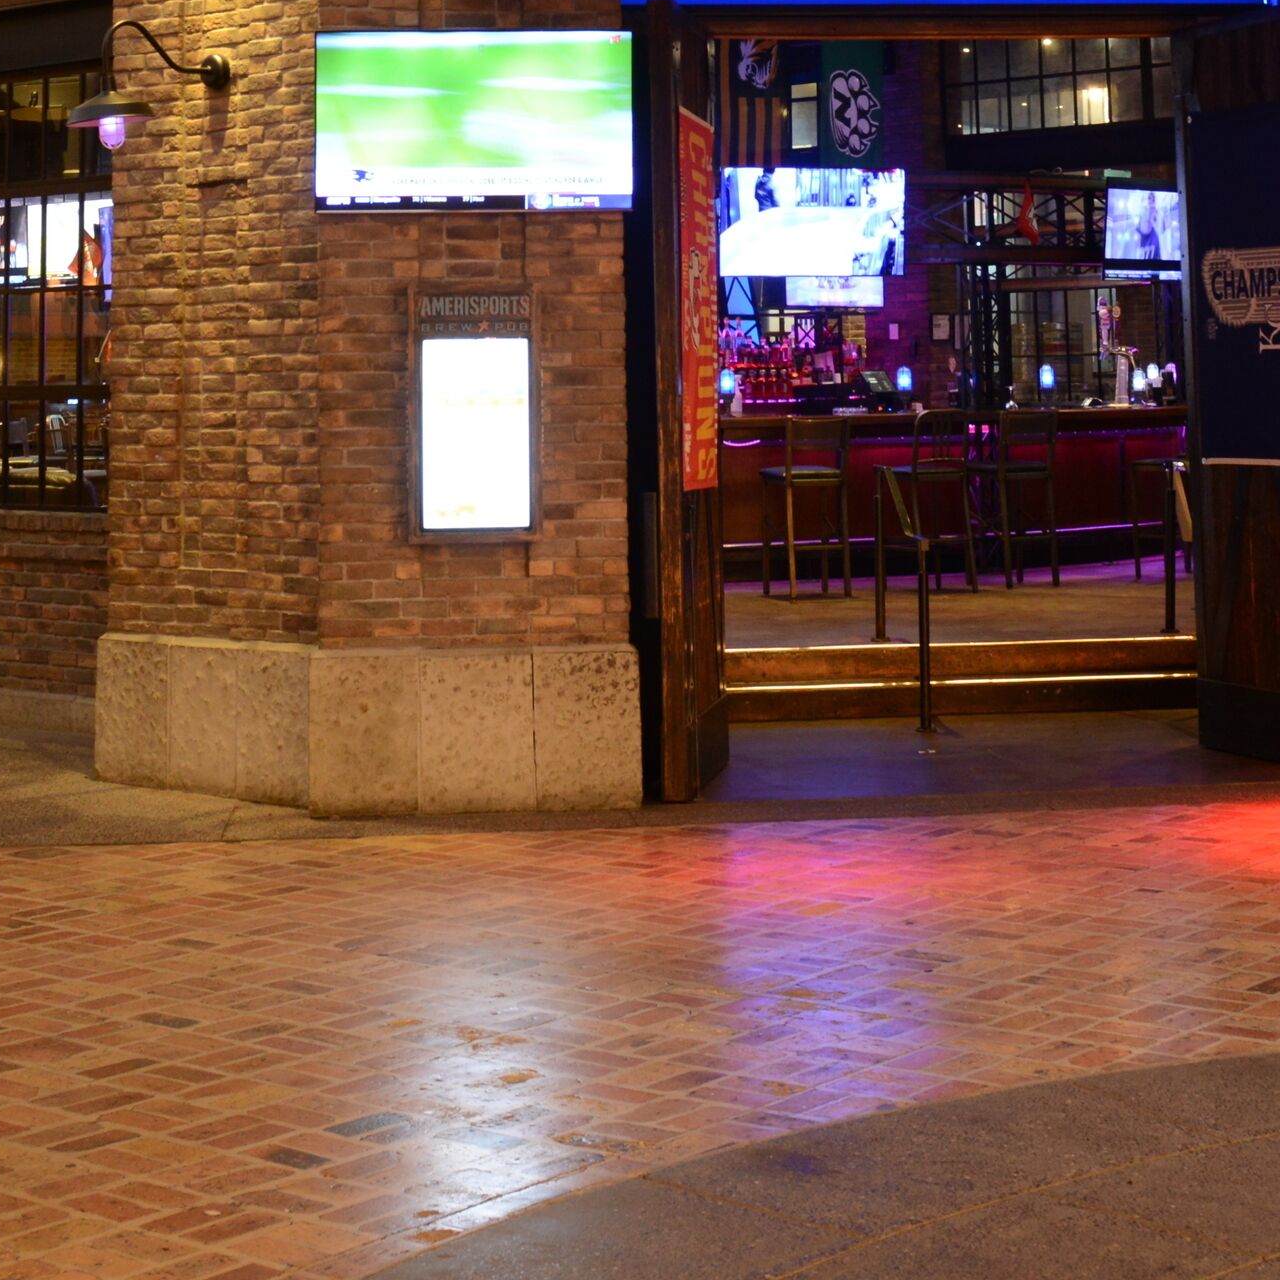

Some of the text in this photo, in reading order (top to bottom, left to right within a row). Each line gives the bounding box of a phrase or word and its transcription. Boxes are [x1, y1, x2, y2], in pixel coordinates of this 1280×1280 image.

[420, 295, 530, 317] AMERISPORTS
[421, 322, 528, 332] BREW PUB
